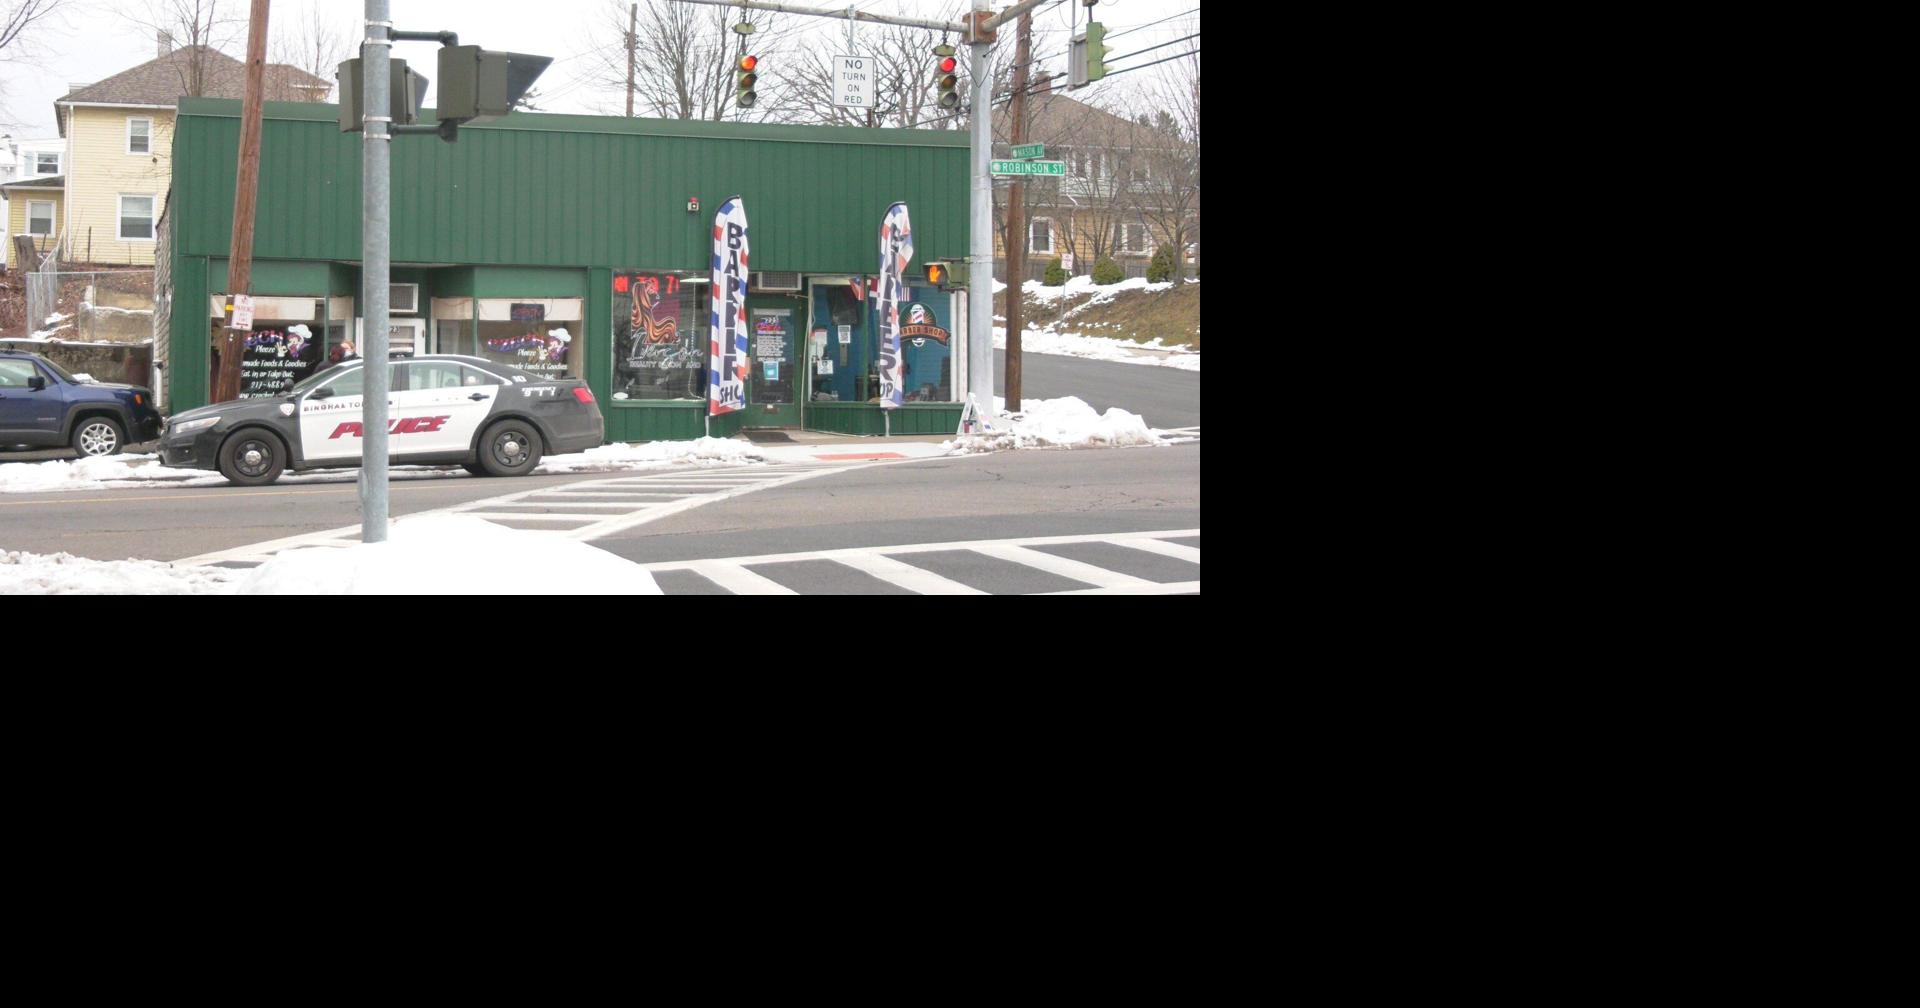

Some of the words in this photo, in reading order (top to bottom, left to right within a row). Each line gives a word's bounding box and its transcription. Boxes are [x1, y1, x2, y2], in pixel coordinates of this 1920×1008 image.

[845, 59, 863, 69] NO
[843, 72, 866, 81] TURN
[847, 84, 860, 92] ON
[844, 95, 862, 104] RED
[1002, 162, 1049, 173] ROBINSON
[1052, 163, 1063, 174] ST
[924, 326, 943, 337] SHOP
[284, 359, 307, 368] Goodies
[719, 385, 741, 403] SHO
